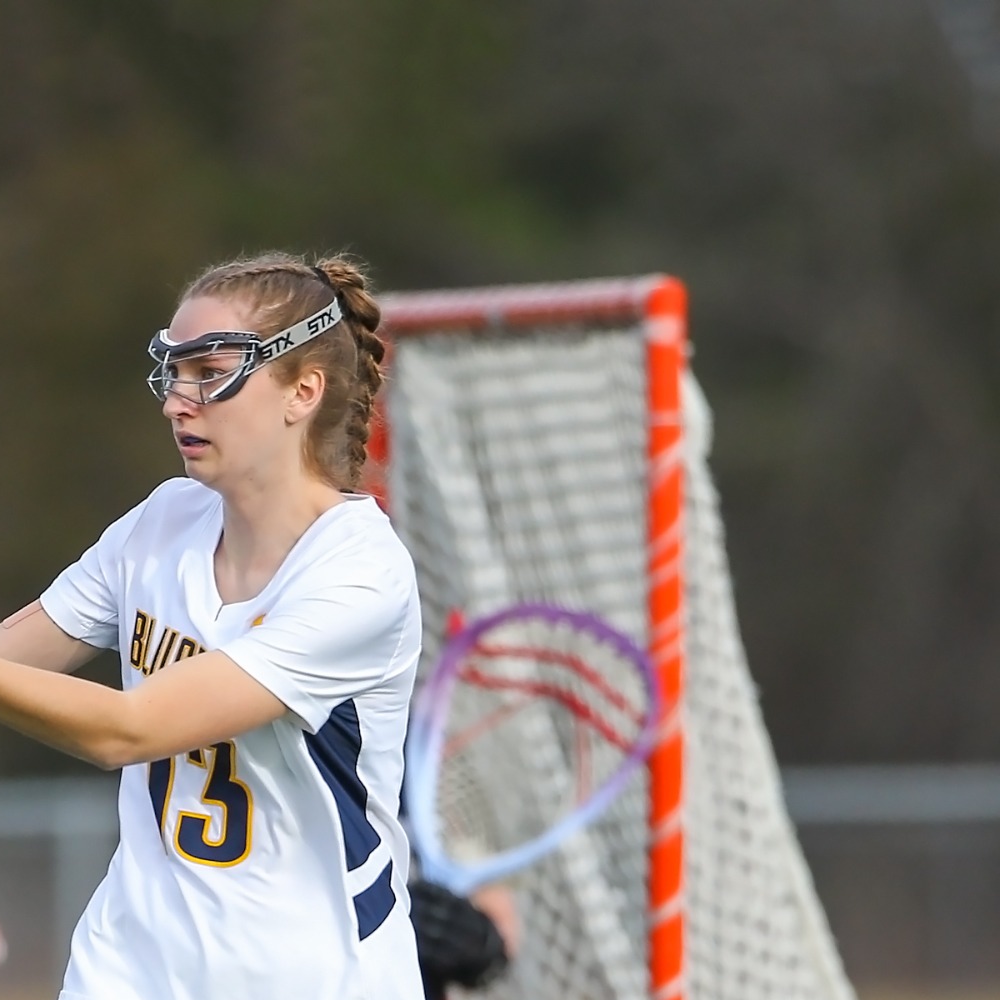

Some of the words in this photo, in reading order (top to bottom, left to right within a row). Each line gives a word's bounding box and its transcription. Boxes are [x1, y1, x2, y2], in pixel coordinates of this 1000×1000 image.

[261, 332, 295, 360] STX
[307, 308, 335, 336] STX
[130, 607, 207, 679] BLU
